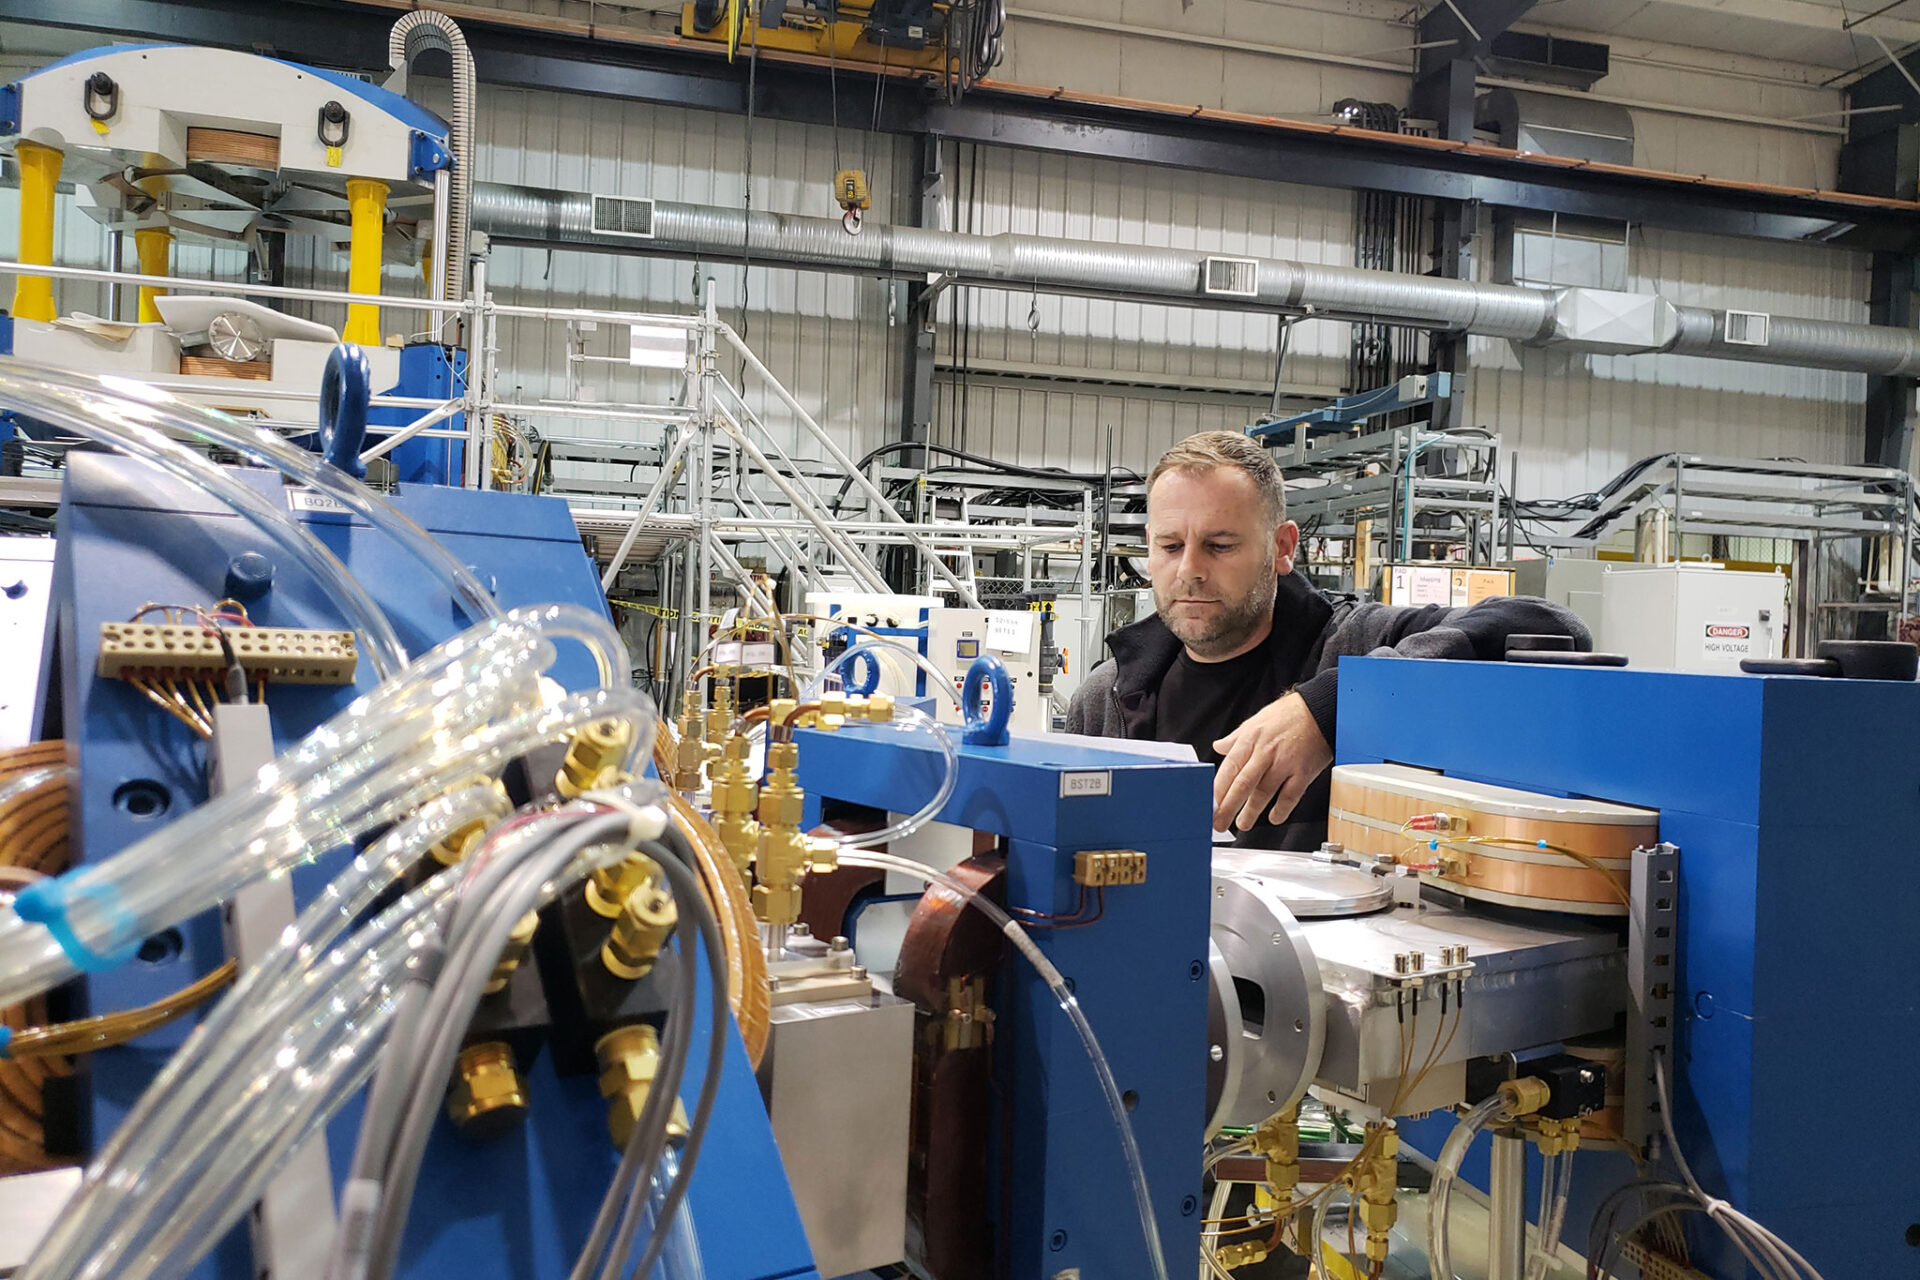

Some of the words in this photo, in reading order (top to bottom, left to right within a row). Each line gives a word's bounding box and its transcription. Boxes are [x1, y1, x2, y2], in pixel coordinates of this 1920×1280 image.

[1396, 575, 1404, 589] 1
[1712, 627, 1743, 637] DANGER
[1705, 643, 1720, 651] HIGH
[1722, 644, 1749, 653] VOLTAGE
[1071, 778, 1102, 790] BST2B
